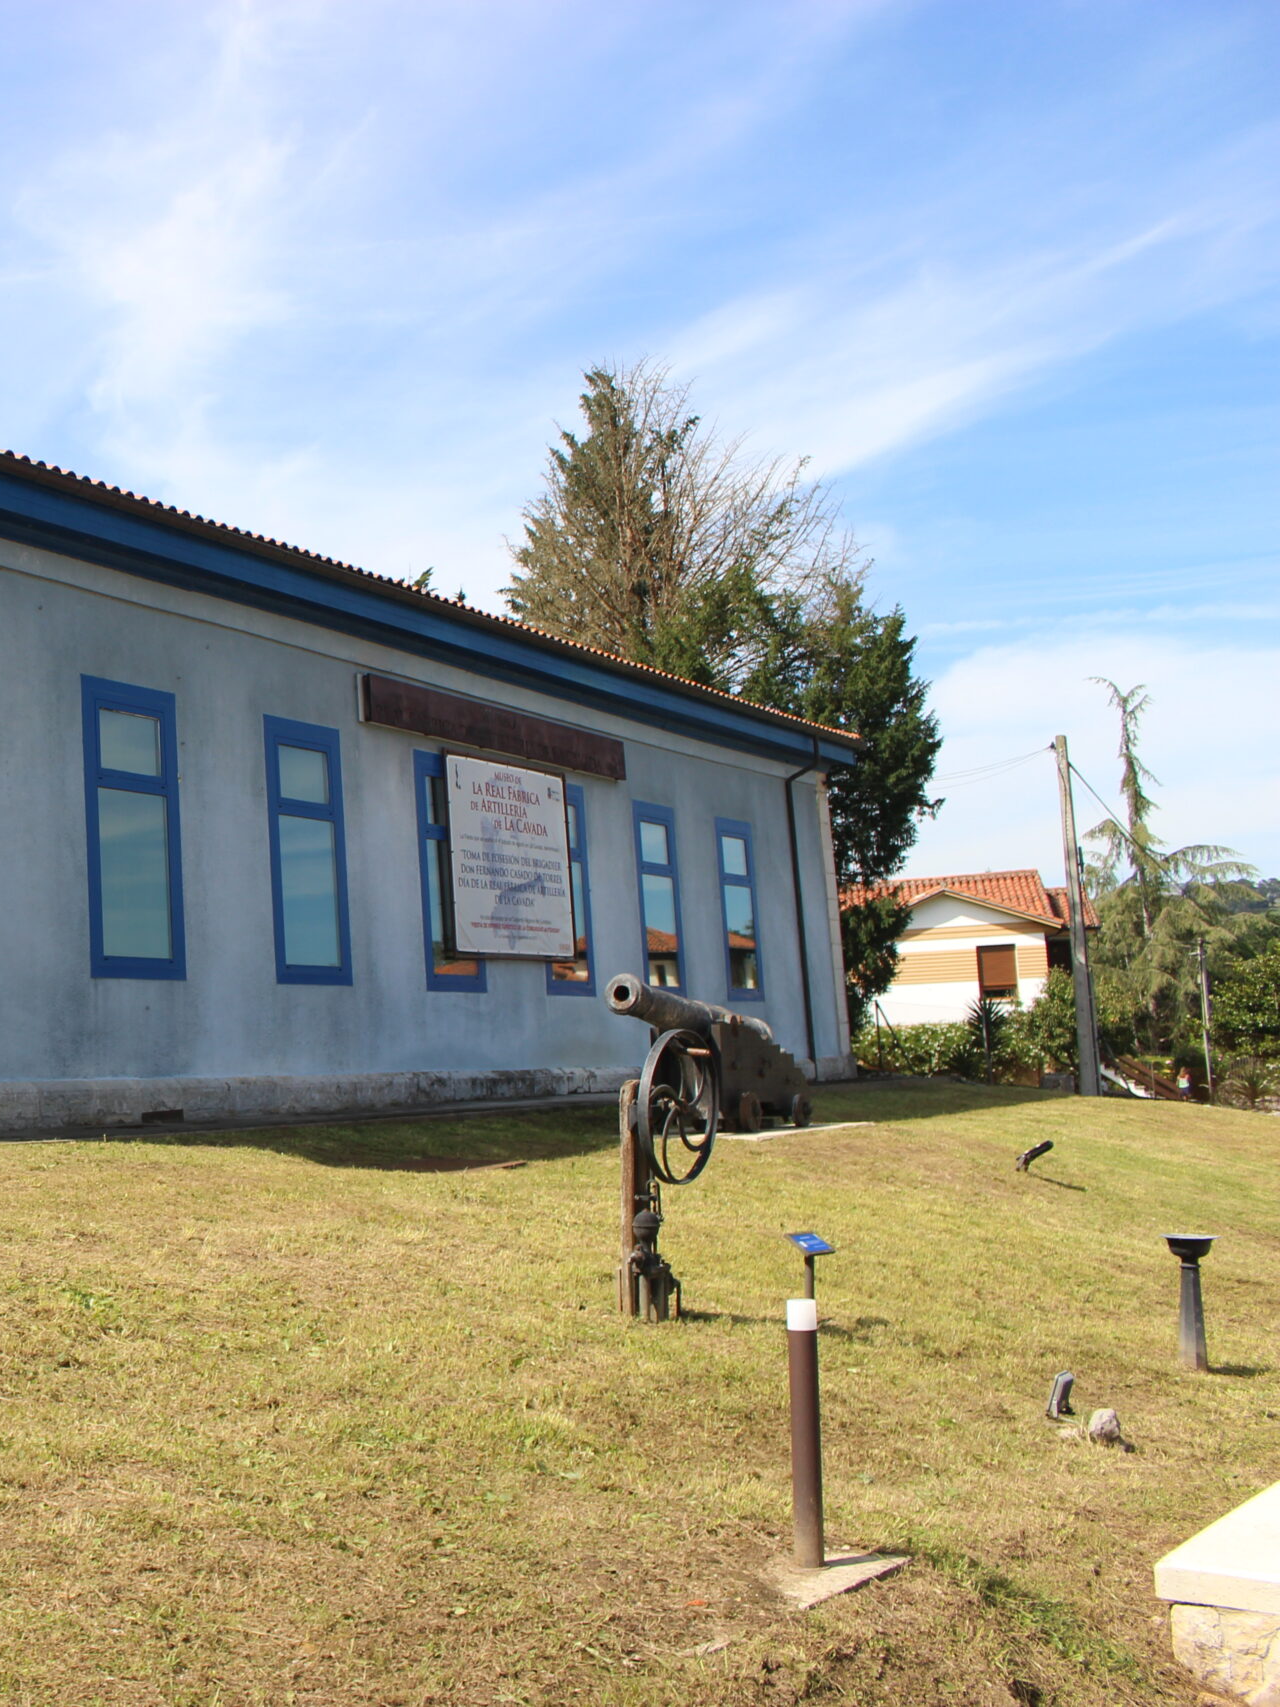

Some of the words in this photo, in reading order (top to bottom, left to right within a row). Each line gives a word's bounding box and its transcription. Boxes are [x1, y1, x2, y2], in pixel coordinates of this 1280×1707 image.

[494, 772, 514, 783] MUSEO
[515, 775, 522, 785] DE
[472, 781, 483, 795] LA
[485, 782, 506, 799] REAL
[470, 800, 479, 811] DE
[481, 798, 528, 819] ARTILLERÍA
[494, 820, 502, 830] DE
[504, 816, 515, 832] LA
[516, 819, 548, 837] CAVADA
[482, 852, 490, 862] DE
[521, 856, 531, 866] DEL
[471, 878, 480, 889] DE
[480, 880, 488, 890] LA
[476, 865, 509, 878] FERNANDO
[510, 869, 533, 880] CASADO
[543, 873, 563, 885] TORRES
